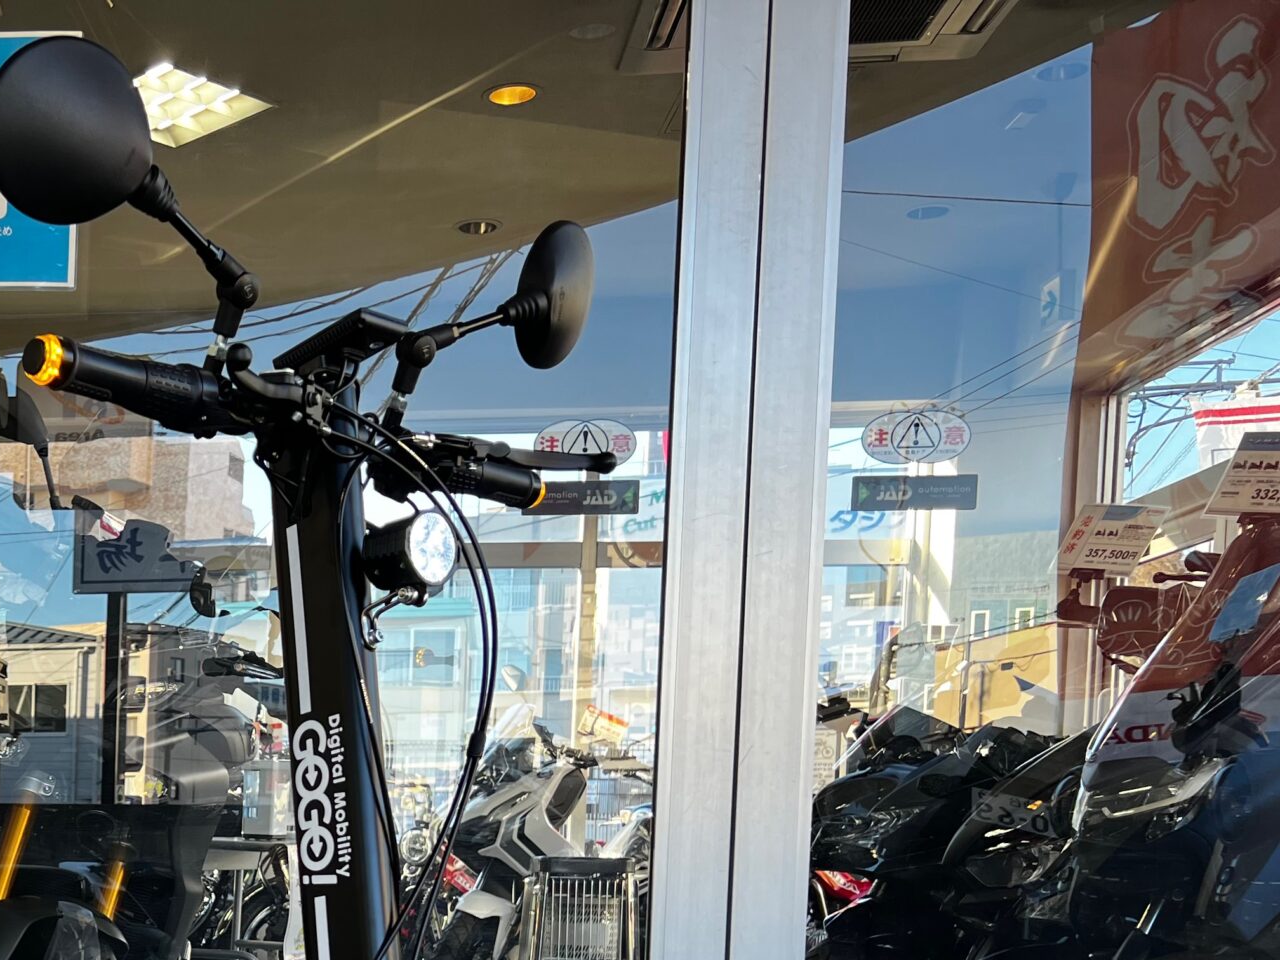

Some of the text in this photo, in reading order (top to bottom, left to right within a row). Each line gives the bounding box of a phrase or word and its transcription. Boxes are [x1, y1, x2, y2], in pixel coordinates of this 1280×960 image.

[292, 719, 338, 885] GOGO!
[326, 713, 353, 878] Digital Mobility
